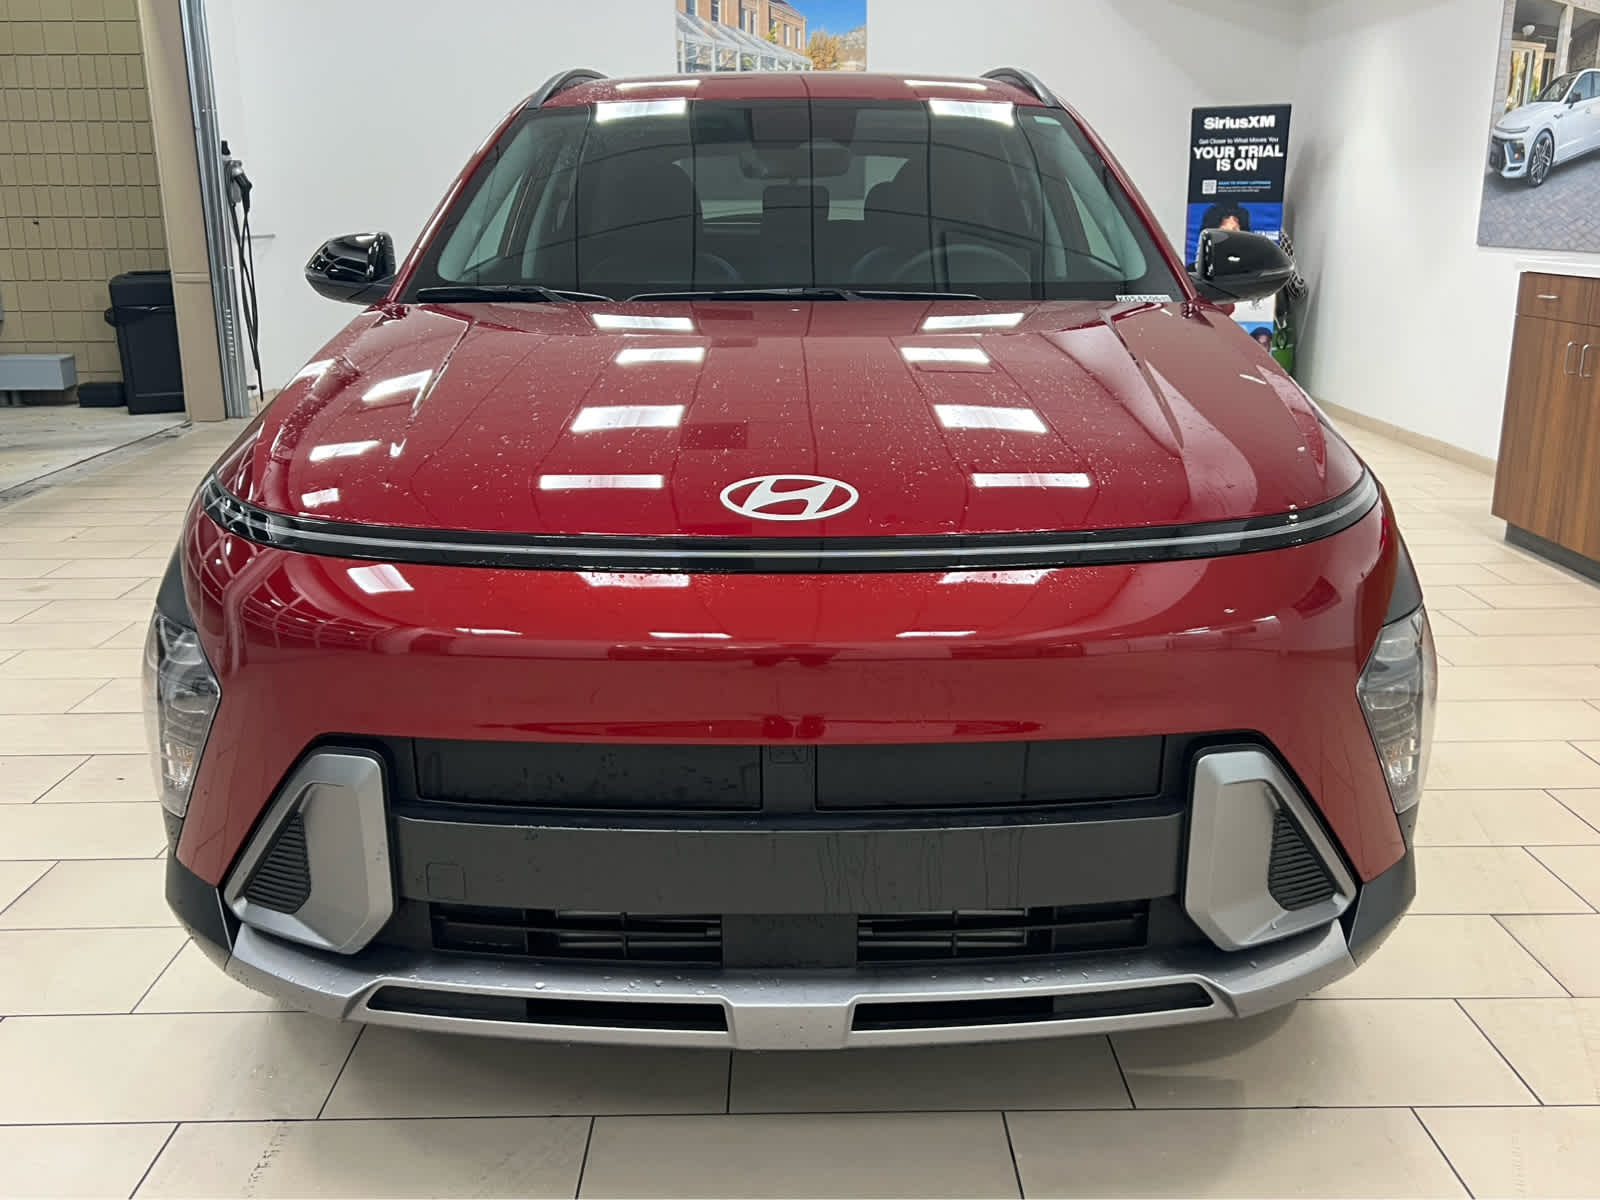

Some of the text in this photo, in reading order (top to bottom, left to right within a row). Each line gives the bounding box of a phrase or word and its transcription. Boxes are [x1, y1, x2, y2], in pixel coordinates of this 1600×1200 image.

[1204, 115, 1275, 129] SiriusXM
[1193, 144, 1284, 159] YOUR TRIAL
[1216, 158, 1258, 172] IS ON
